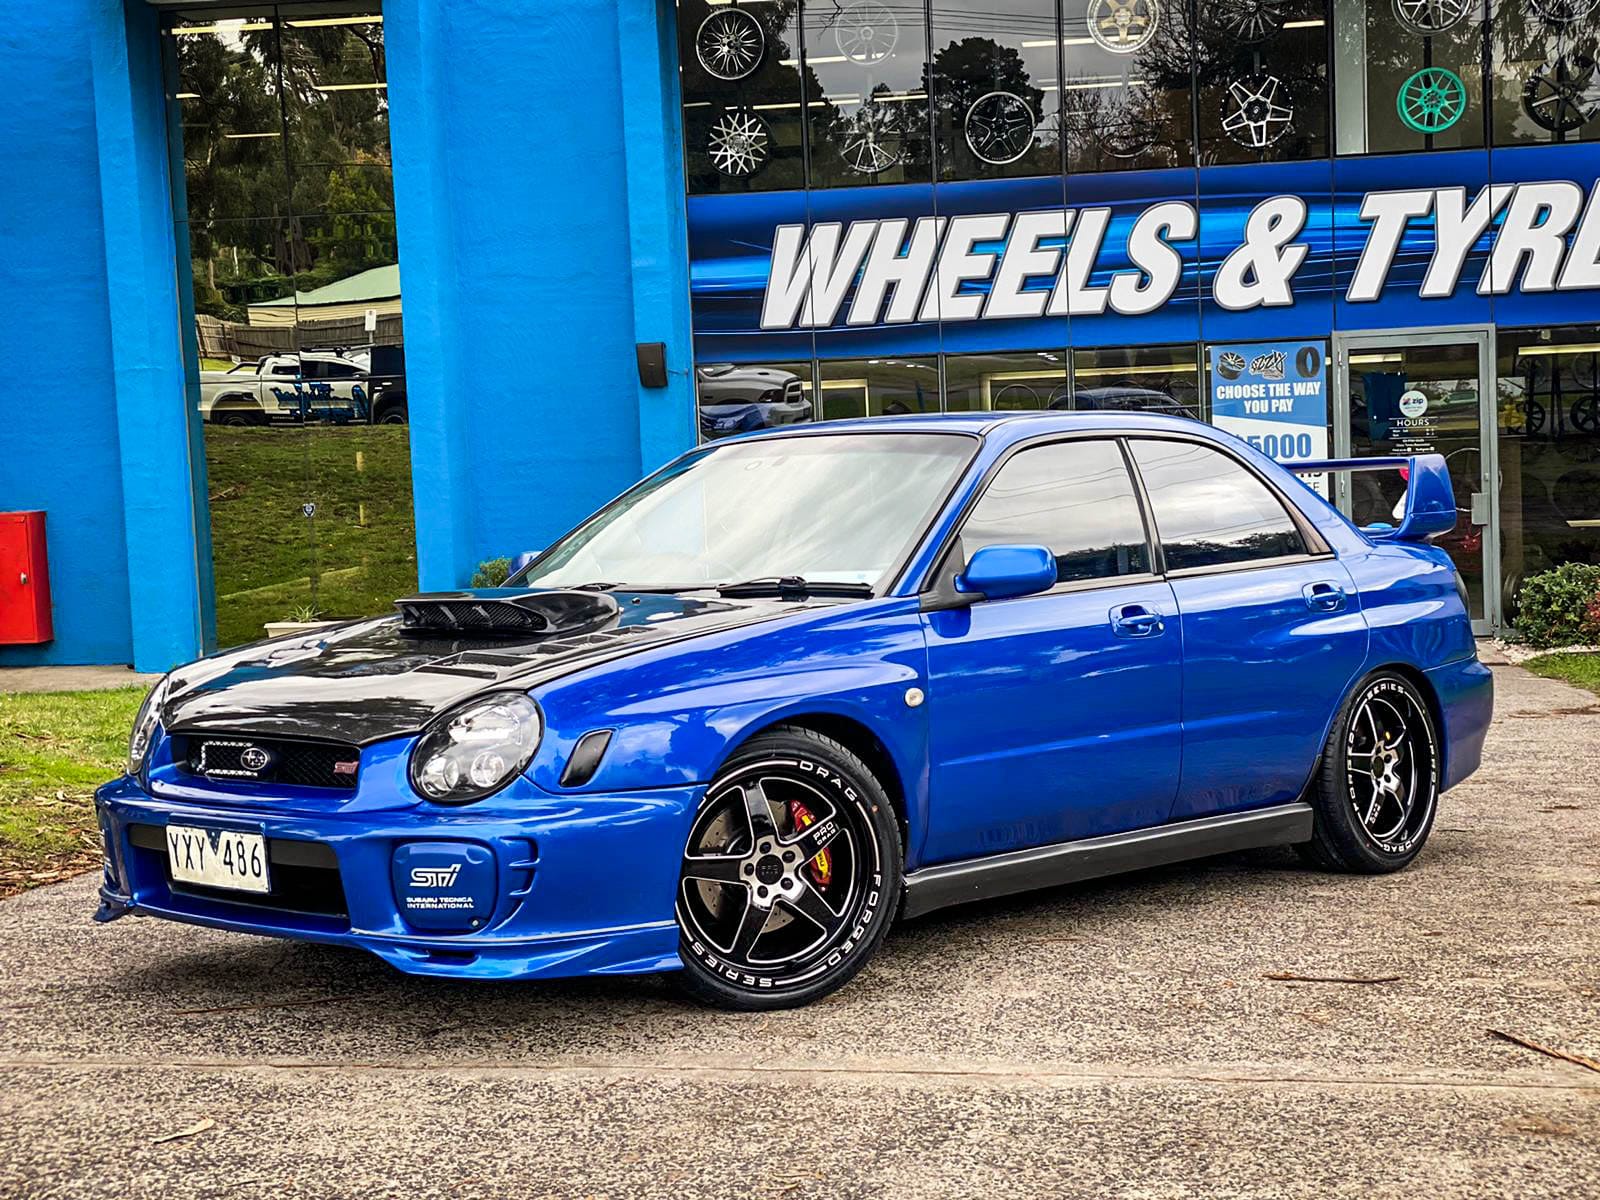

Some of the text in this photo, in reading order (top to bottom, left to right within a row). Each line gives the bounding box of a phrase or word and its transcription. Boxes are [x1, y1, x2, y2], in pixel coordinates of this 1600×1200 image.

[760, 200, 1197, 329] WHEELS
[1213, 194, 1309, 311] &
[1216, 381, 1321, 399] CHOOSE THE WAY
[1244, 398, 1294, 414] YOU PAY
[1396, 418, 1430, 427] HOURS
[1366, 683, 1405, 700] SERIES
[799, 760, 858, 802] DRAG
[812, 821, 834, 841] PRO
[169, 832, 262, 878] YXY 486
[1383, 840, 1412, 852] DRAG
[828, 874, 881, 965] FORGED
[691, 941, 772, 988] SERIES
